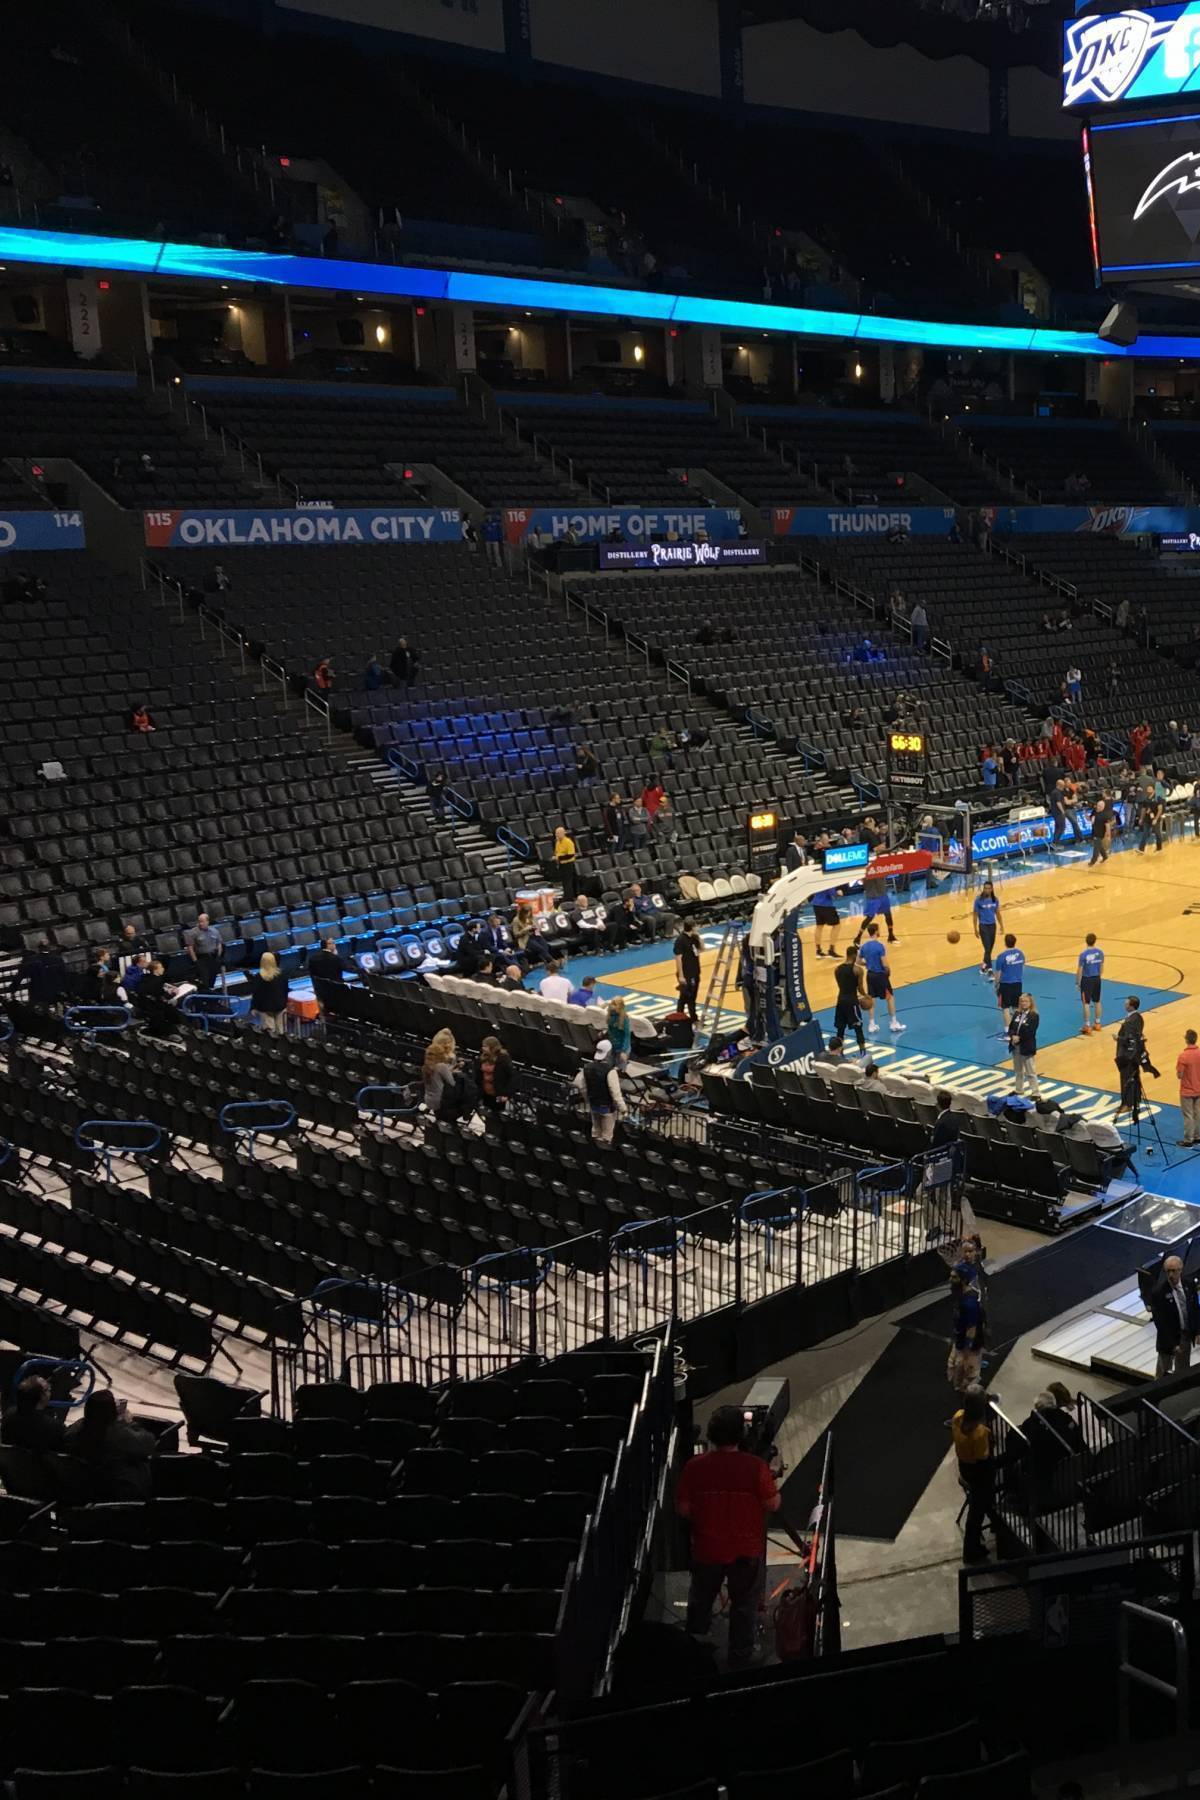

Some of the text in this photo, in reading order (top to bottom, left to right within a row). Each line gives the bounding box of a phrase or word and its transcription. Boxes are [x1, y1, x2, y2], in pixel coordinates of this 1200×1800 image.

[1075, 25, 1133, 78] OKC
[53, 513, 82, 528] 114
[147, 512, 173, 527] 115
[441, 510, 460, 523] 115
[507, 510, 527, 523] 116
[725, 510, 742, 521] 116
[775, 509, 791, 520] 117
[827, 513, 912, 532] THUNDER
[179, 516, 435, 544] OKLAHOMA CITY
[664, 514, 707, 535] THE
[607, 543, 761, 566] DISTILLERY PRAIRIE WOLF DISTILLERY
[891, 735, 921, 752] 66:30
[900, 776, 925, 785] TISSOT
[792, 936, 802, 999] DRAFTKINGS
